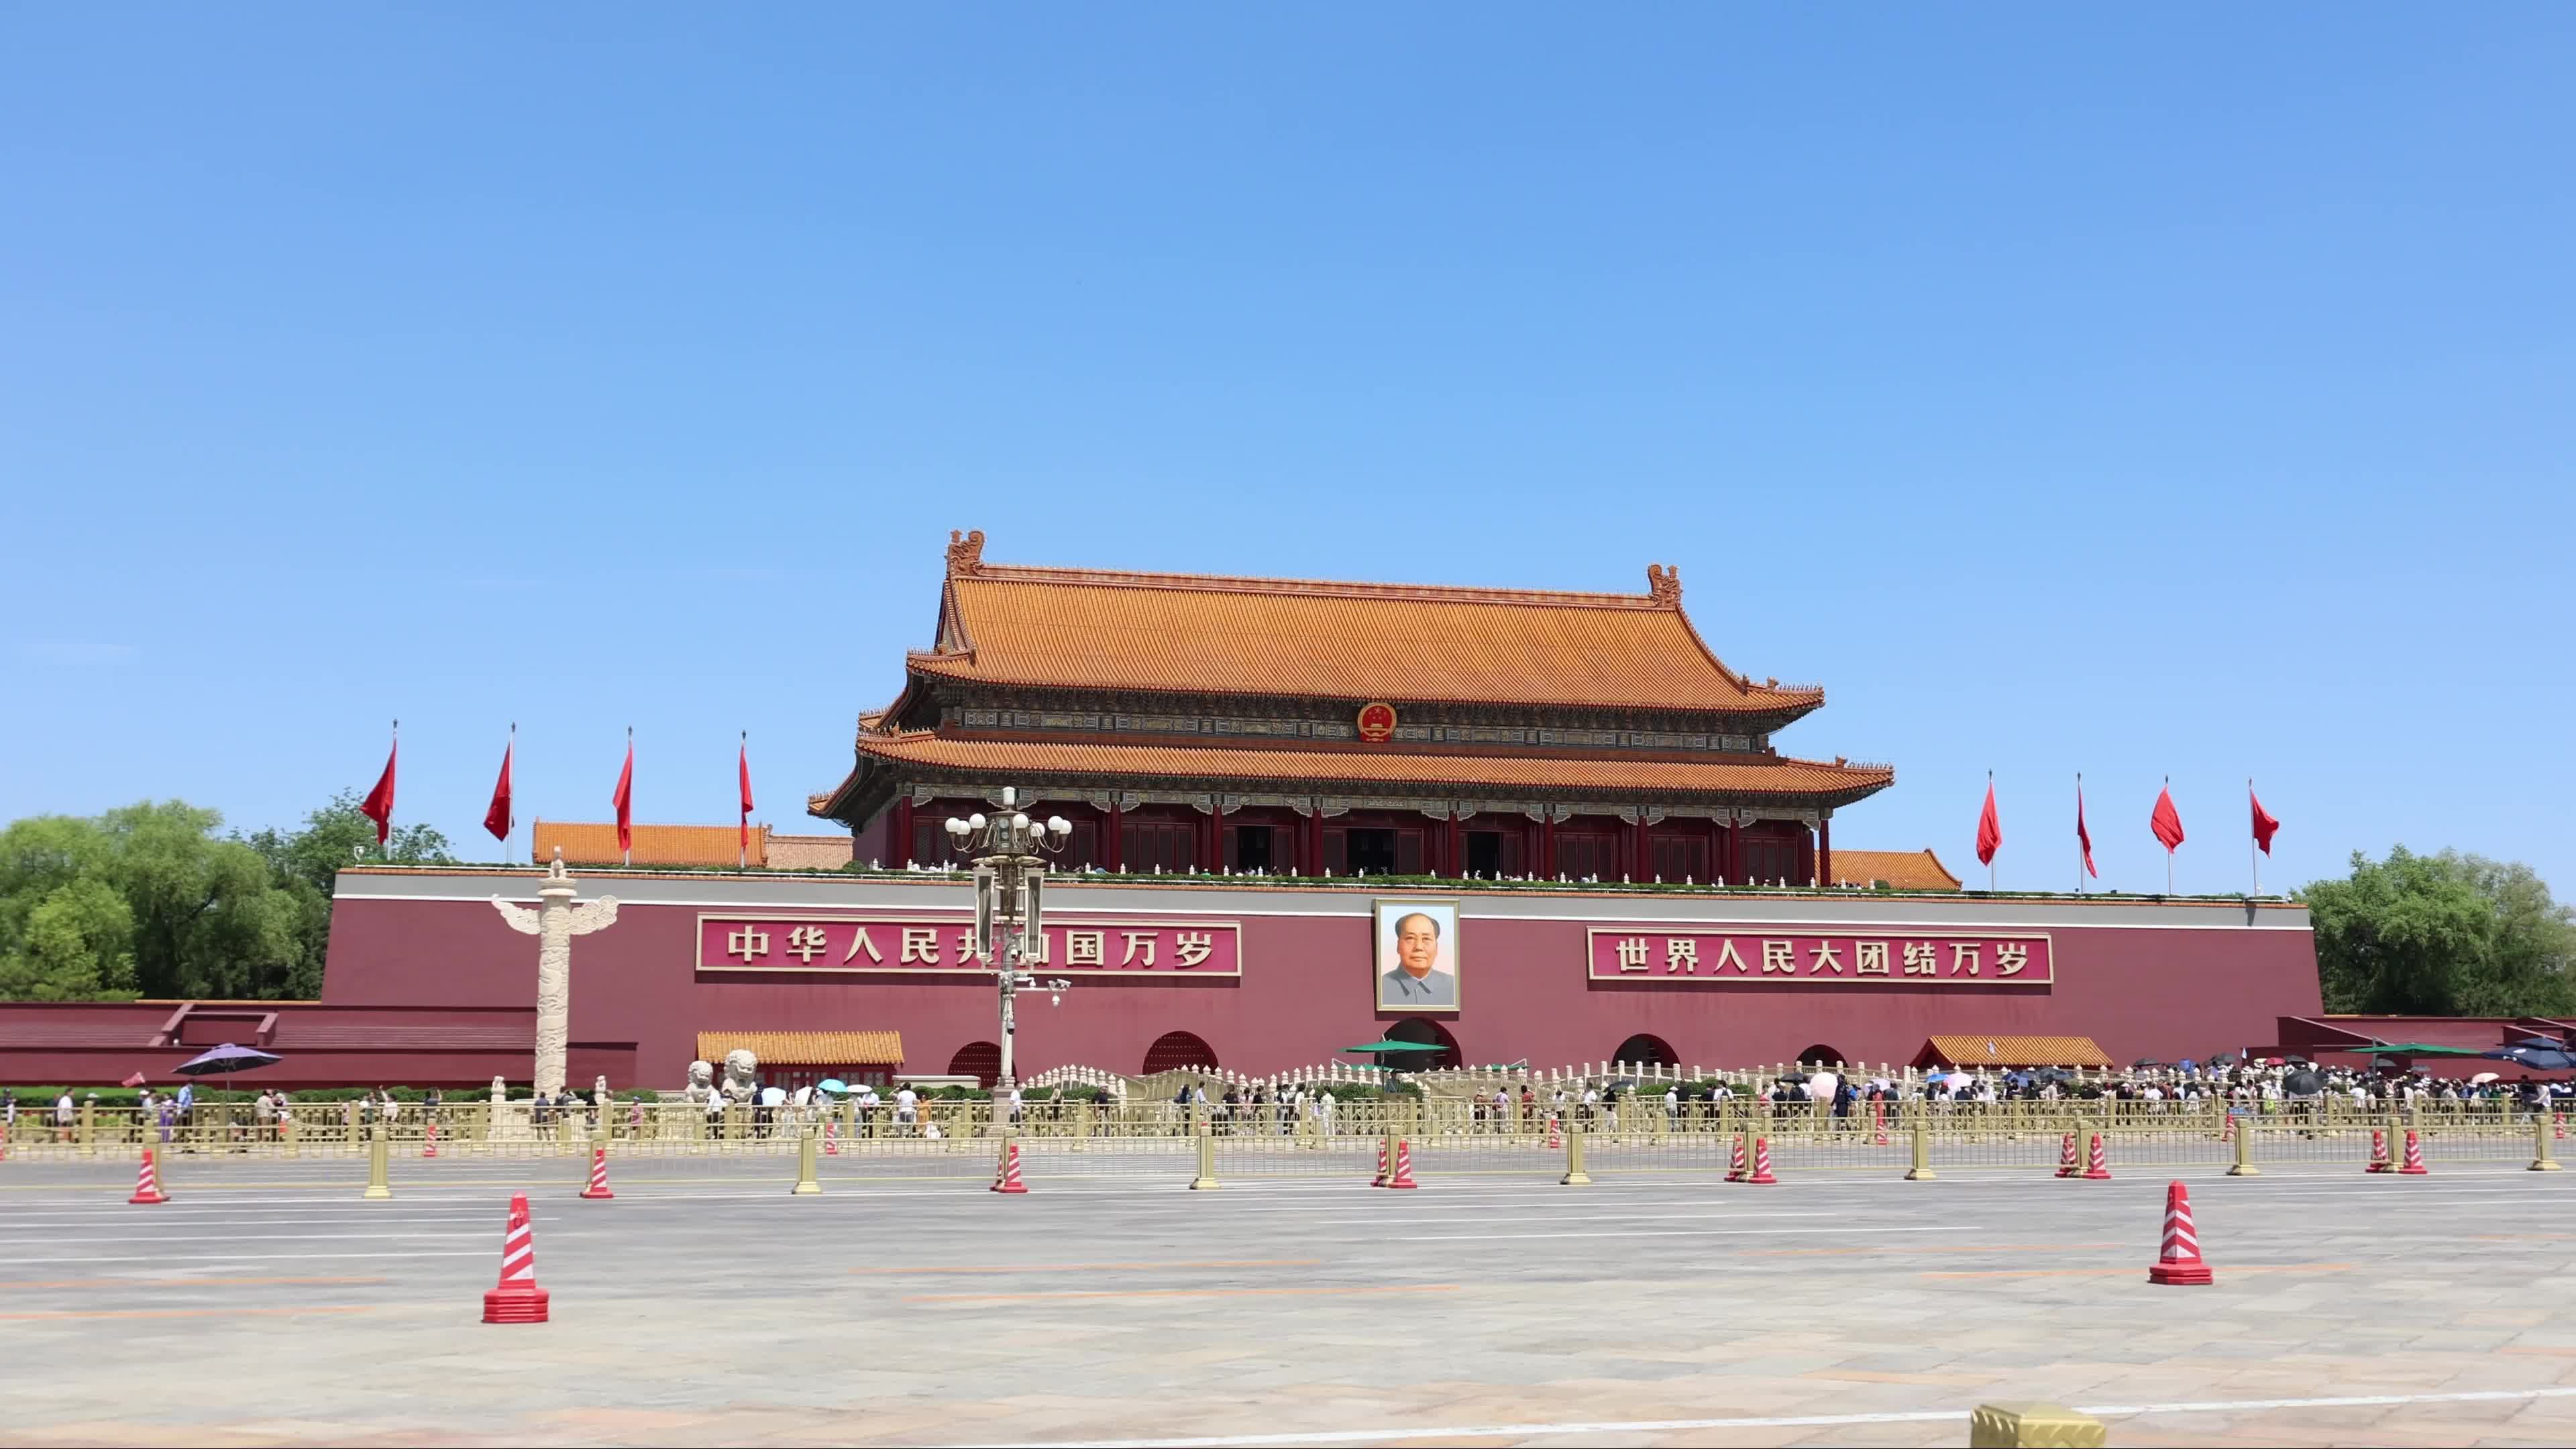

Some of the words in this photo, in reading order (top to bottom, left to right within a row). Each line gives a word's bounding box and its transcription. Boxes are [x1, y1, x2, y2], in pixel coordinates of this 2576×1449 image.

[1615, 938, 2028, 975] 世界人民大团结万岁
